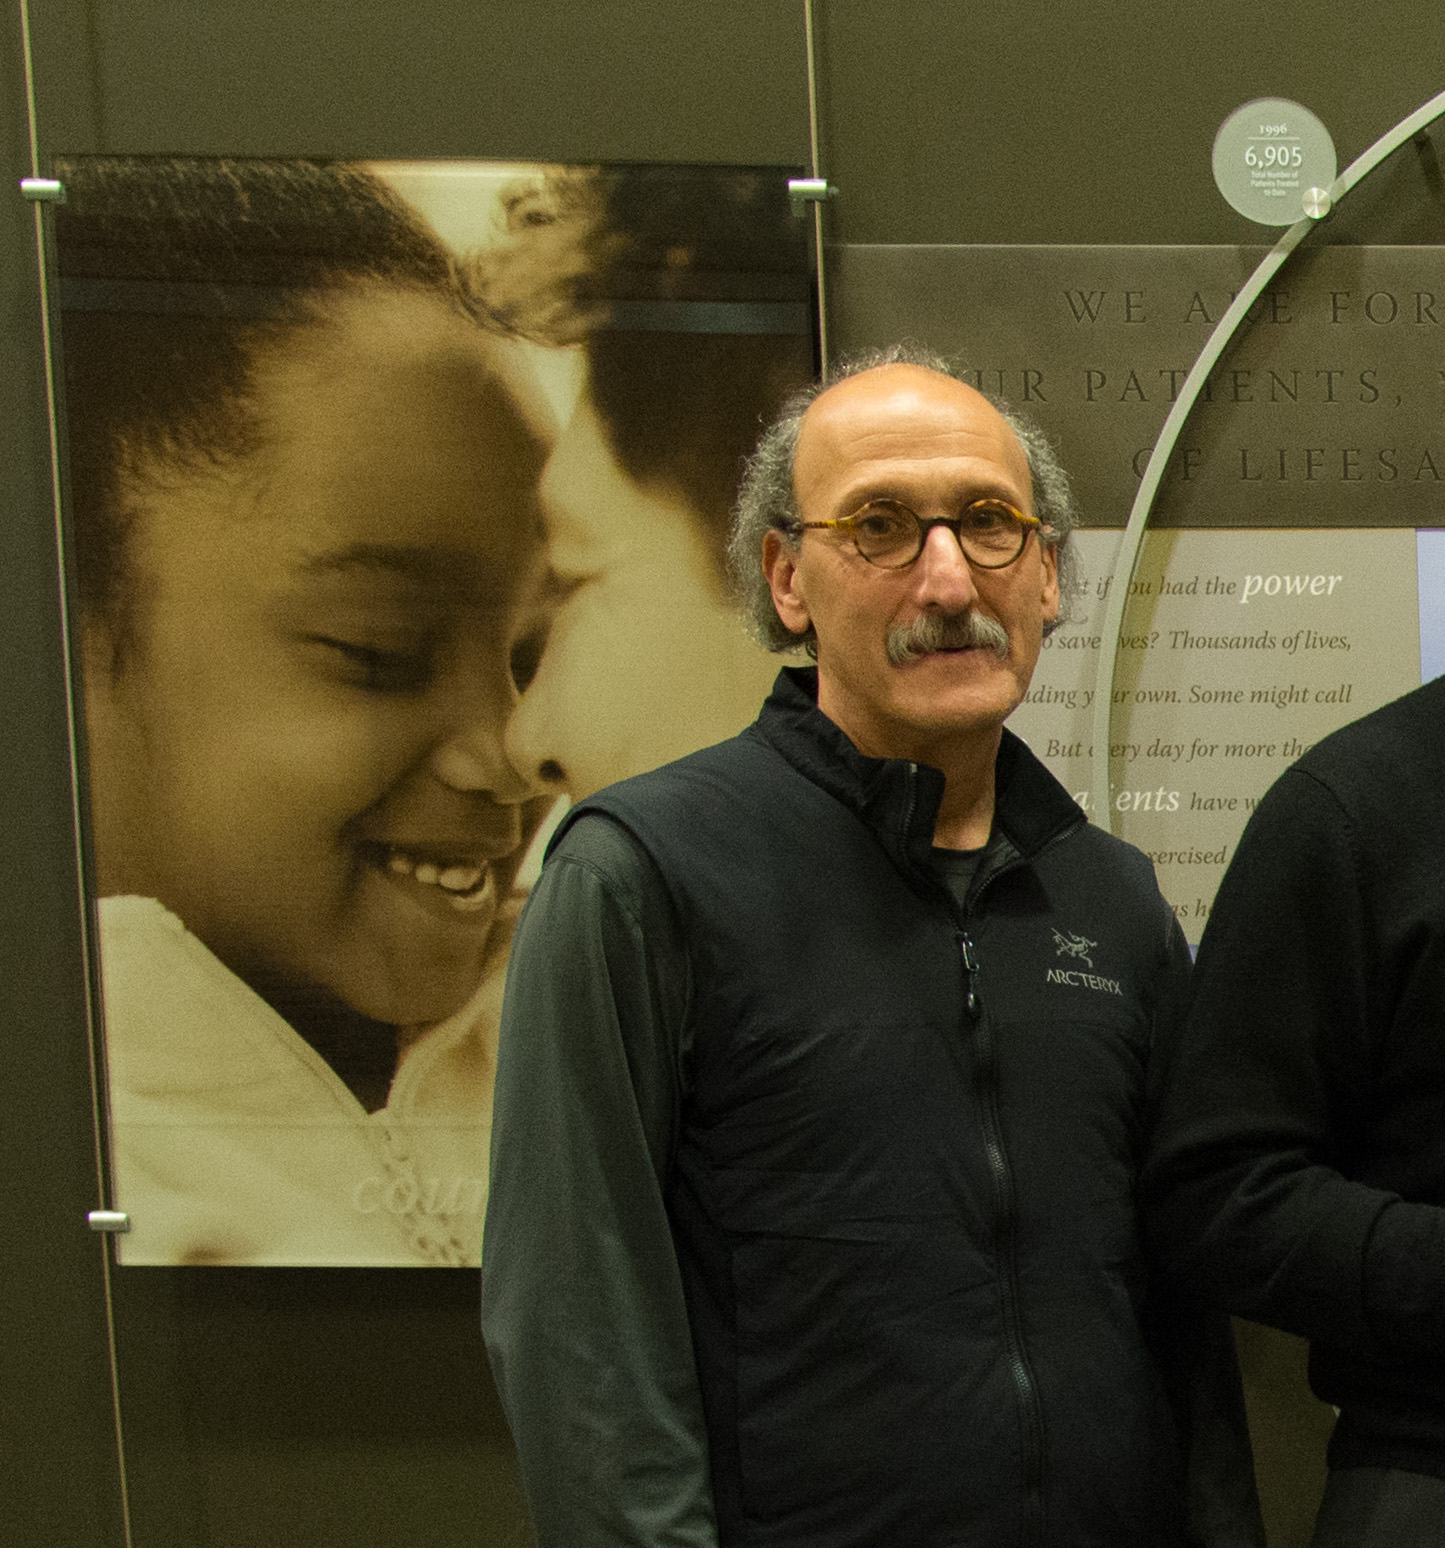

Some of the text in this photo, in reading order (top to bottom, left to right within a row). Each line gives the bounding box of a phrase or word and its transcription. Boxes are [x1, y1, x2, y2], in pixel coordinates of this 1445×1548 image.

[1259, 123, 1288, 136] 1996
[1245, 145, 1302, 169] 6,905
[1063, 290, 1148, 325] WE
[974, 369, 1048, 402] UR
[1240, 448, 1442, 483] LIFESA
[1096, 575, 1114, 600] if
[1128, 581, 1152, 596] ou
[1159, 575, 1199, 595] had
[1205, 575, 1237, 595] the
[1238, 573, 1343, 604] power
[1057, 635, 1101, 650] save
[1119, 631, 1160, 650] ves?
[1168, 630, 1277, 650] Thousands
[1281, 629, 1304, 655] of
[1306, 630, 1352, 653] lives,
[1081, 689, 1130, 709] yur
[1135, 689, 1182, 704] own.
[1189, 685, 1243, 704] Some
[1250, 684, 1309, 710] might
[1314, 684, 1354, 704] call
[1045, 738, 1314, 763] But ery day for more tha
[1072, 783, 1181, 812] aents
[1189, 792, 1238, 812] have
[1147, 845, 1228, 865] xercised
